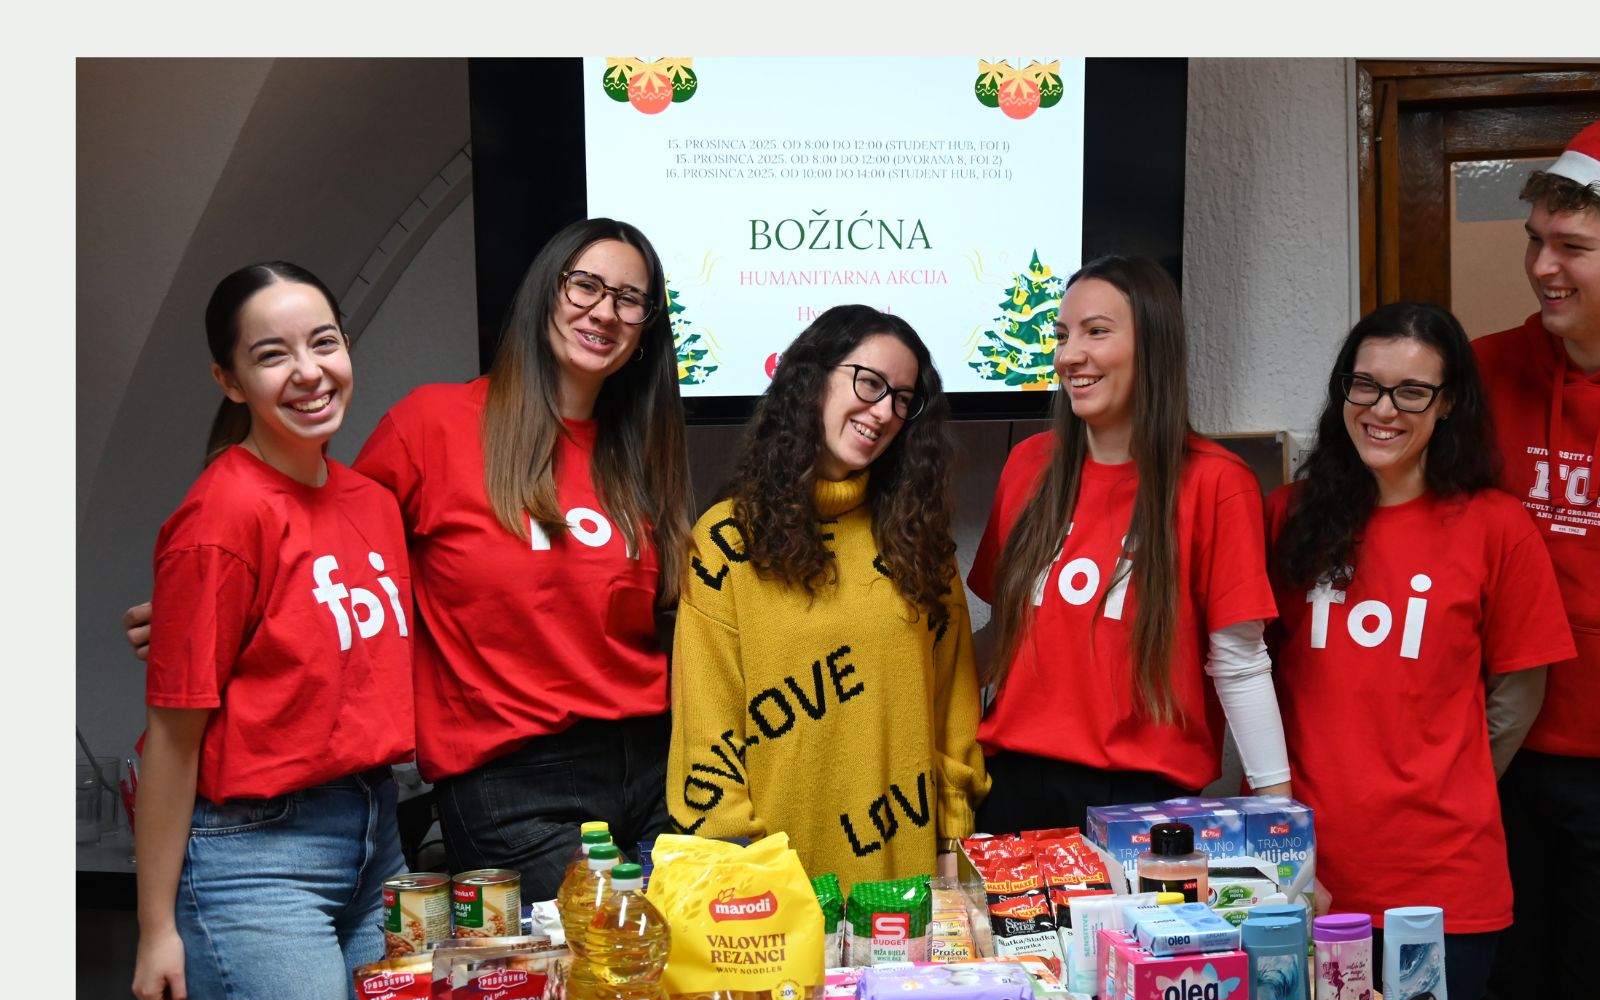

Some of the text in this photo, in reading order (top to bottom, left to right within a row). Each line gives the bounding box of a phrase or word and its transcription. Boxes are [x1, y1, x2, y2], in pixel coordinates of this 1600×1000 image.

[668, 139, 681, 150] 15.
[685, 139, 746, 150] PROSINCA
[782, 140, 801, 150] OD
[804, 140, 829, 150] 8:00
[833, 140, 851, 150] DO
[854, 140, 883, 150] 12:00
[885, 140, 945, 152] (STUDENT
[980, 141, 999, 151] FOI
[676, 154, 690, 164] 15.
[693, 154, 754, 165] PROSINCA
[790, 154, 809, 165] OD
[812, 154, 837, 165] 8:00
[840, 155, 859, 165] DO
[862, 155, 890, 165] 12:00
[893, 154, 954, 166] (DVORANA
[970, 155, 989, 165] FOI
[666, 168, 680, 179] 16.
[683, 168, 744, 179] PROSINCA
[780, 169, 799, 179] OD
[803, 169, 832, 179] 10:00
[835, 169, 854, 179] DO
[857, 169, 885, 180] 14:00
[888, 169, 948, 181] (STUDENT
[982, 170, 1001, 180] FOI
[749, 208, 933, 251] BOŽIĆNA
[740, 269, 948, 286] HUMANITARNA AKCIJA
[312, 551, 410, 652] foi
[839, 771, 936, 858] LOV
[1257, 836, 1302, 850] TRAJNO
[1254, 848, 1307, 866] Mlijeko
[715, 898, 771, 915] marodi
[706, 933, 786, 950] VALOVITI
[1167, 935, 1191, 947] olea
[711, 948, 786, 965] REZANCI
[873, 948, 887, 956] RIŽA
[932, 948, 969, 957] Prašak
[367, 974, 413, 991] PODRAVKA
[482, 972, 525, 987] PODRAVKA
